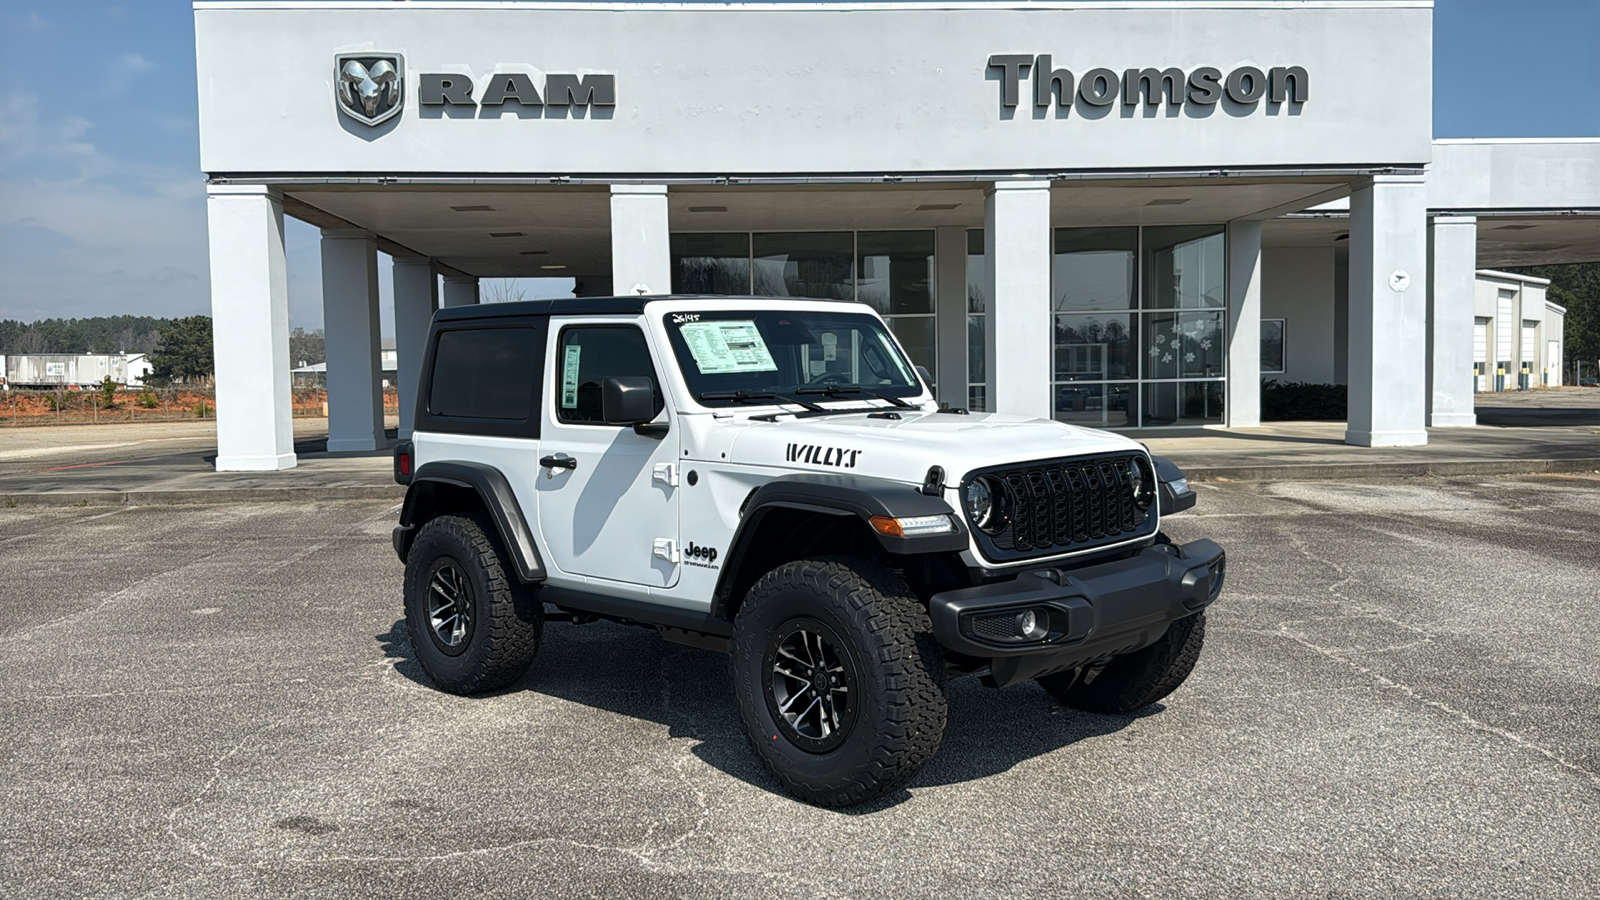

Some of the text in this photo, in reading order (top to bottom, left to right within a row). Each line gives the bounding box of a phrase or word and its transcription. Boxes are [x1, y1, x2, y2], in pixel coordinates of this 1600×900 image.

[418, 73, 616, 105] RAM
[988, 54, 1309, 106] Thomson
[786, 443, 862, 468] WILLYS
[684, 541, 718, 562] Jeep
